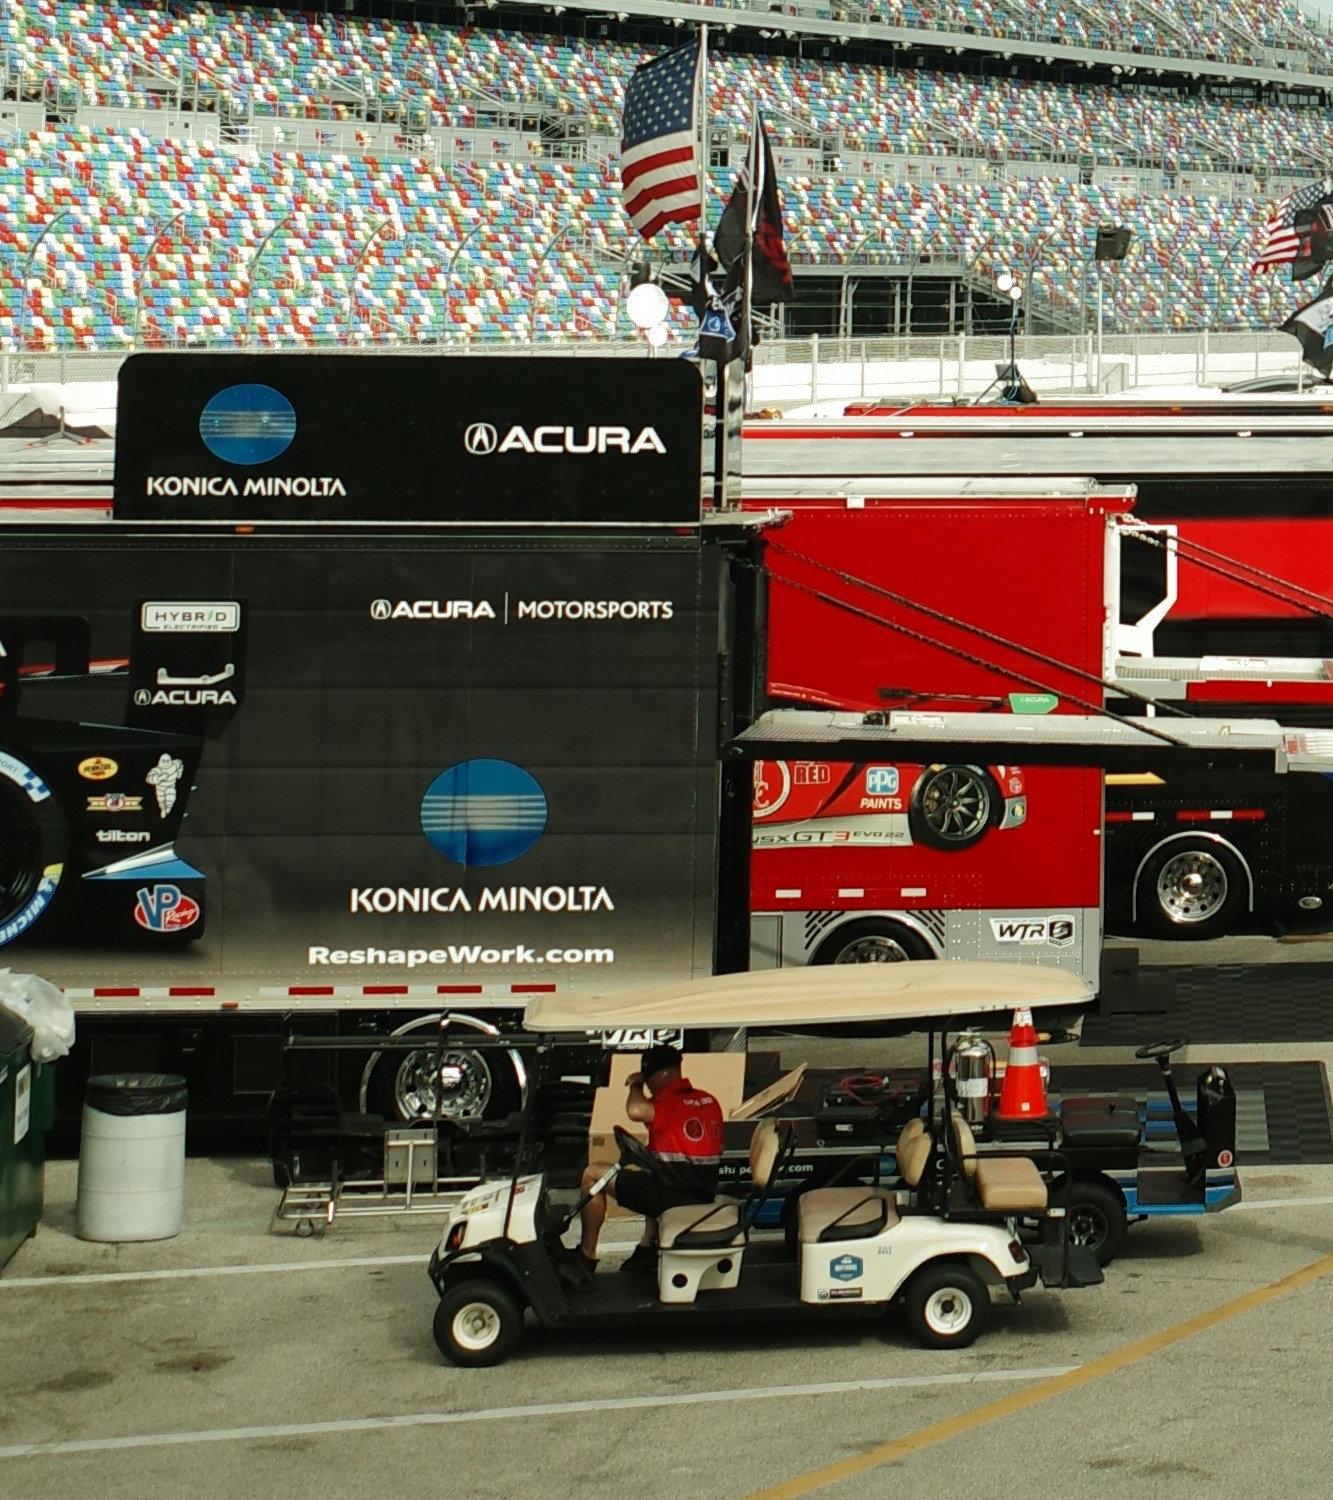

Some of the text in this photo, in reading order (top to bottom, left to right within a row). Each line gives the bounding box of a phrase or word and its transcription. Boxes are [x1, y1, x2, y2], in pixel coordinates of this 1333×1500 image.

[498, 425, 667, 454] ACURA
[146, 476, 347, 497] KONICA MINOLTA
[155, 610, 228, 623] HYBRID
[392, 599, 674, 620] ACURA MOTORSPORTS
[151, 690, 238, 705] ACURA
[794, 765, 831, 785] RED
[867, 769, 898, 792] PPG
[860, 798, 902, 810] PAINTS
[96, 829, 151, 842] tilton
[137, 884, 181, 932] VP
[350, 886, 615, 913] KONICA MINOLTA
[999, 923, 1046, 941] WTR
[308, 944, 615, 968] ReshapeWork.com
